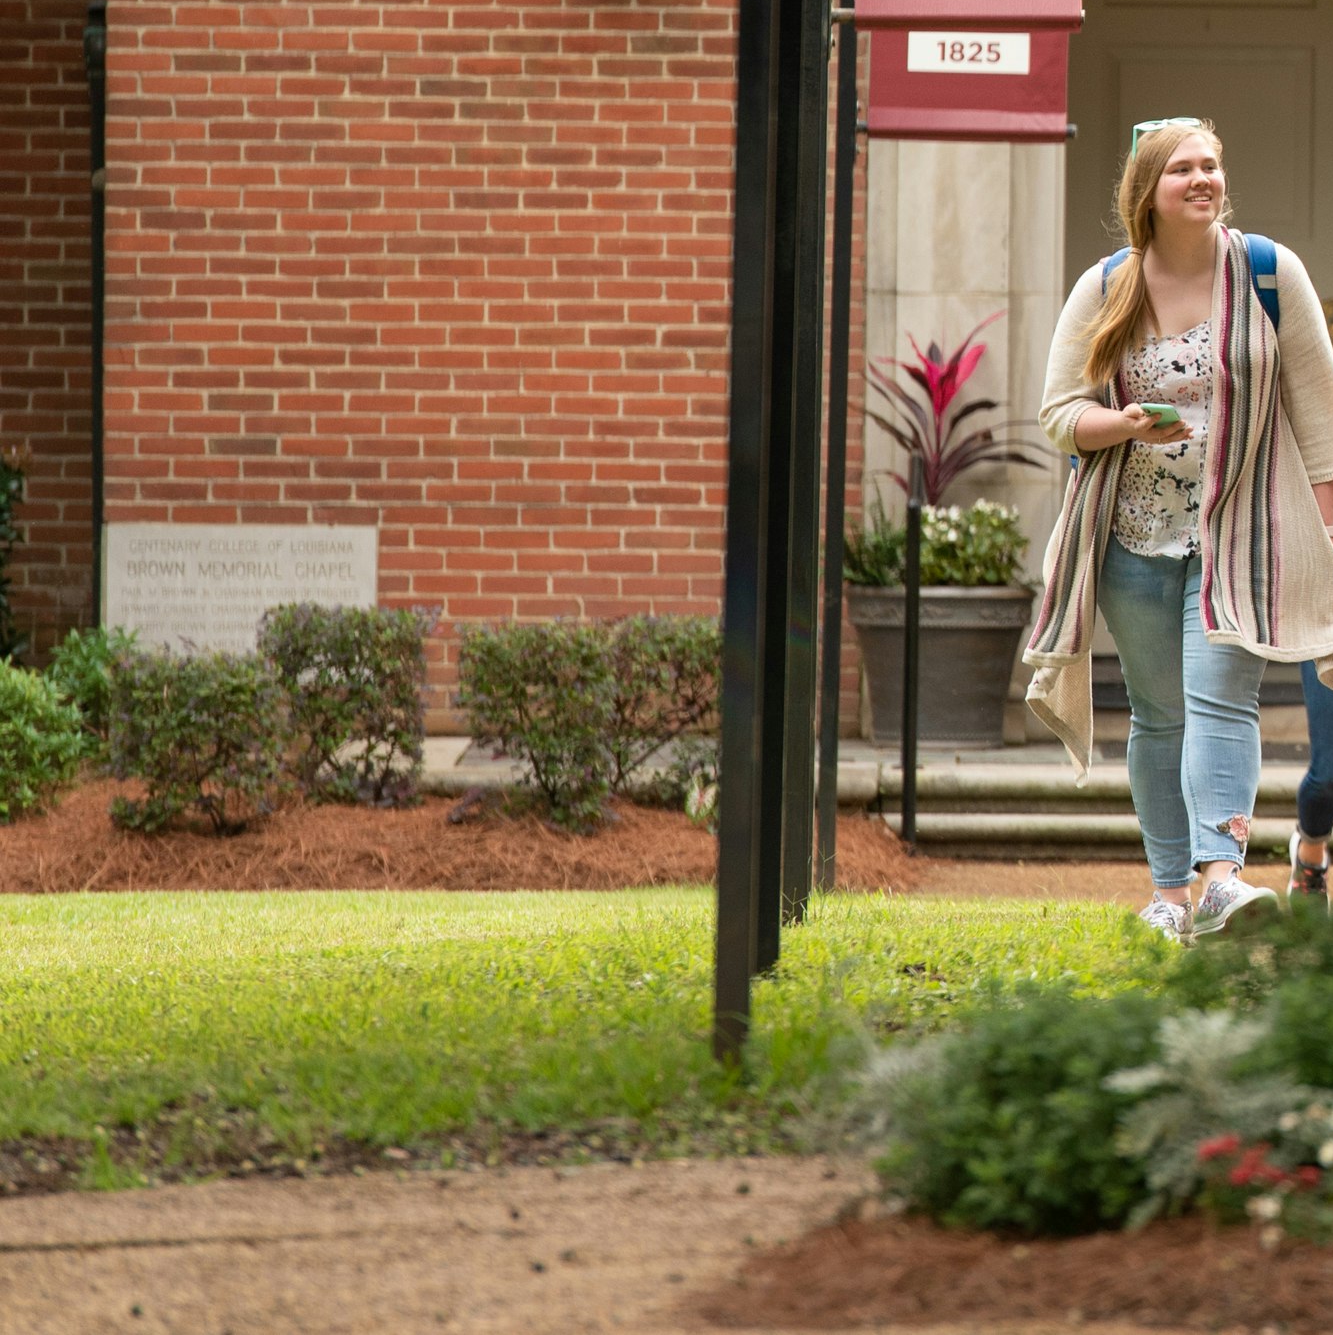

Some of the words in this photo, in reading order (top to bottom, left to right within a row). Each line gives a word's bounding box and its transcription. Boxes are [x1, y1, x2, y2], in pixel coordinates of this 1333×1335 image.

[936, 41, 1002, 64] 1825
[129, 538, 200, 555] CENTENARY
[209, 539, 260, 555] COLLEGE
[268, 539, 283, 554] OF
[290, 539, 354, 555] LOUISIANA
[126, 560, 186, 579] BROWN
[199, 561, 281, 580] MEMORIAL
[294, 561, 356, 581] CHAPEL
